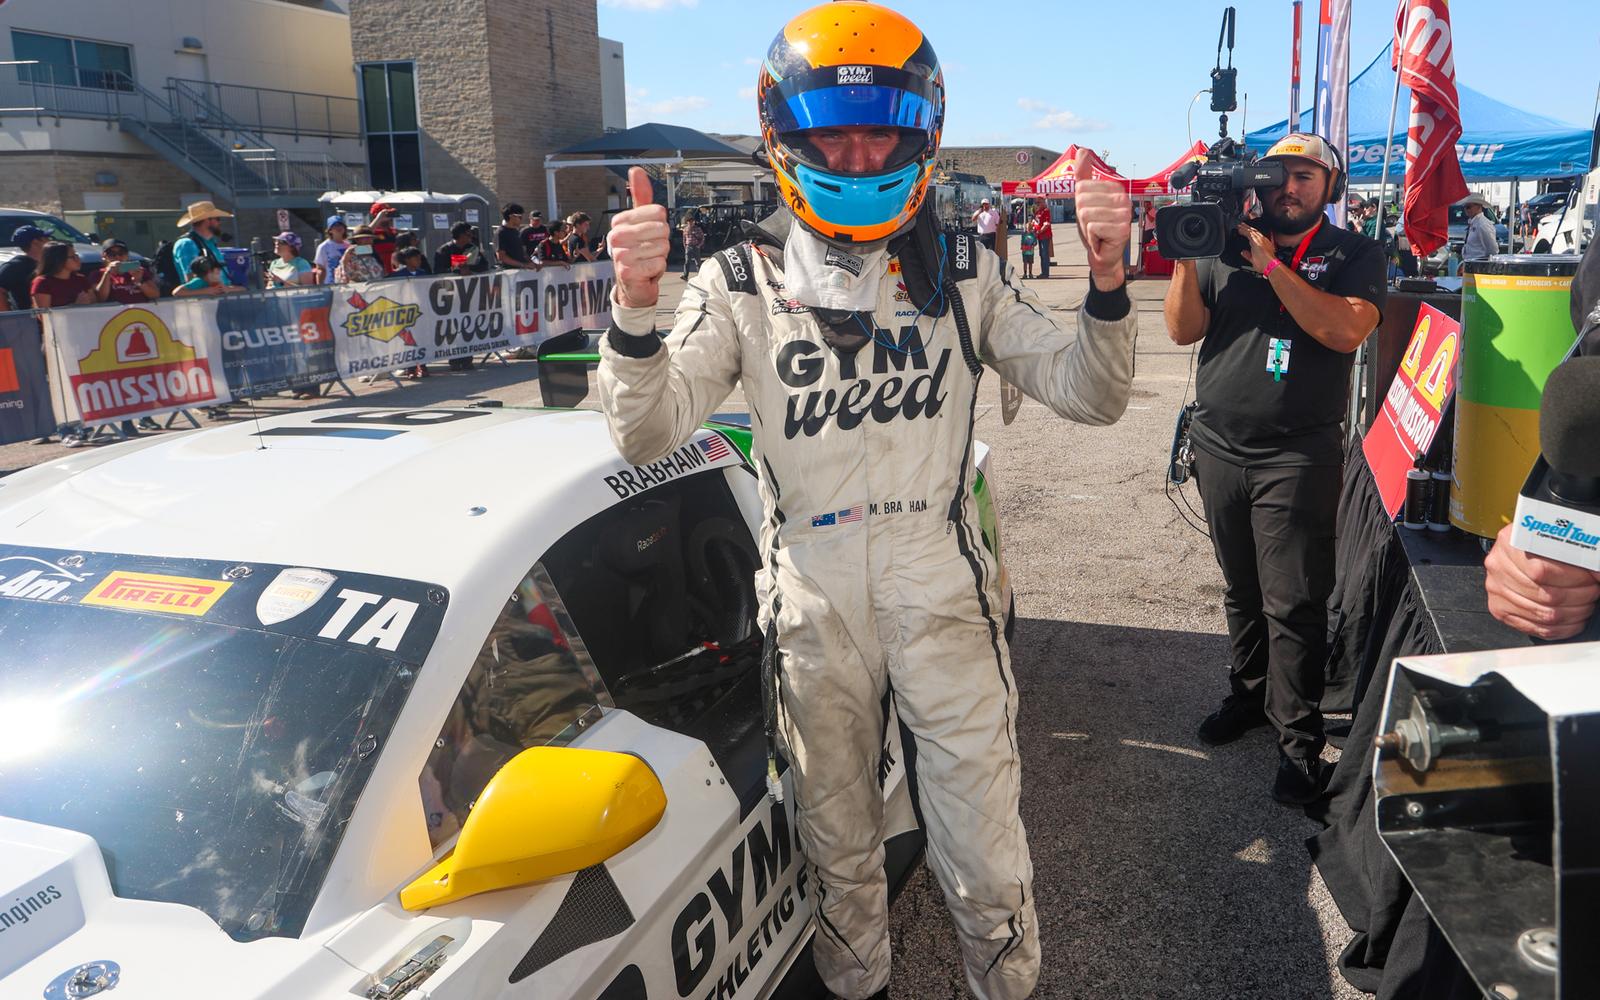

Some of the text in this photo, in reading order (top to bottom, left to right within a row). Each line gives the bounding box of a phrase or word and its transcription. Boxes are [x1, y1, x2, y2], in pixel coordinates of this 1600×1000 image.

[838, 66, 867, 76] GYM
[838, 72, 871, 83] weed
[935, 159, 959, 170] AFE
[1037, 180, 1075, 193] MISSI
[724, 248, 748, 281] sparco
[956, 235, 970, 270] sparco
[428, 277, 503, 315] GYM
[544, 278, 613, 322] OPTIMA
[351, 307, 417, 332] SUNOCO
[434, 311, 504, 346] weed
[894, 310, 918, 318] RACE
[223, 321, 320, 351] CUBE3
[434, 346, 468, 359] ATHLETIC
[469, 342, 491, 353] FOCUS
[349, 348, 426, 374] RACE FUELS
[776, 325, 929, 388] GYM
[77, 366, 210, 413] MISSION
[784, 348, 952, 440] weed
[604, 443, 706, 499] BRABHAM
[869, 503, 881, 516] M.
[98, 577, 216, 608] PIRELLI
[317, 588, 420, 652] TA
[0, 885, 62, 932] ngines
[671, 802, 791, 998] GYM
